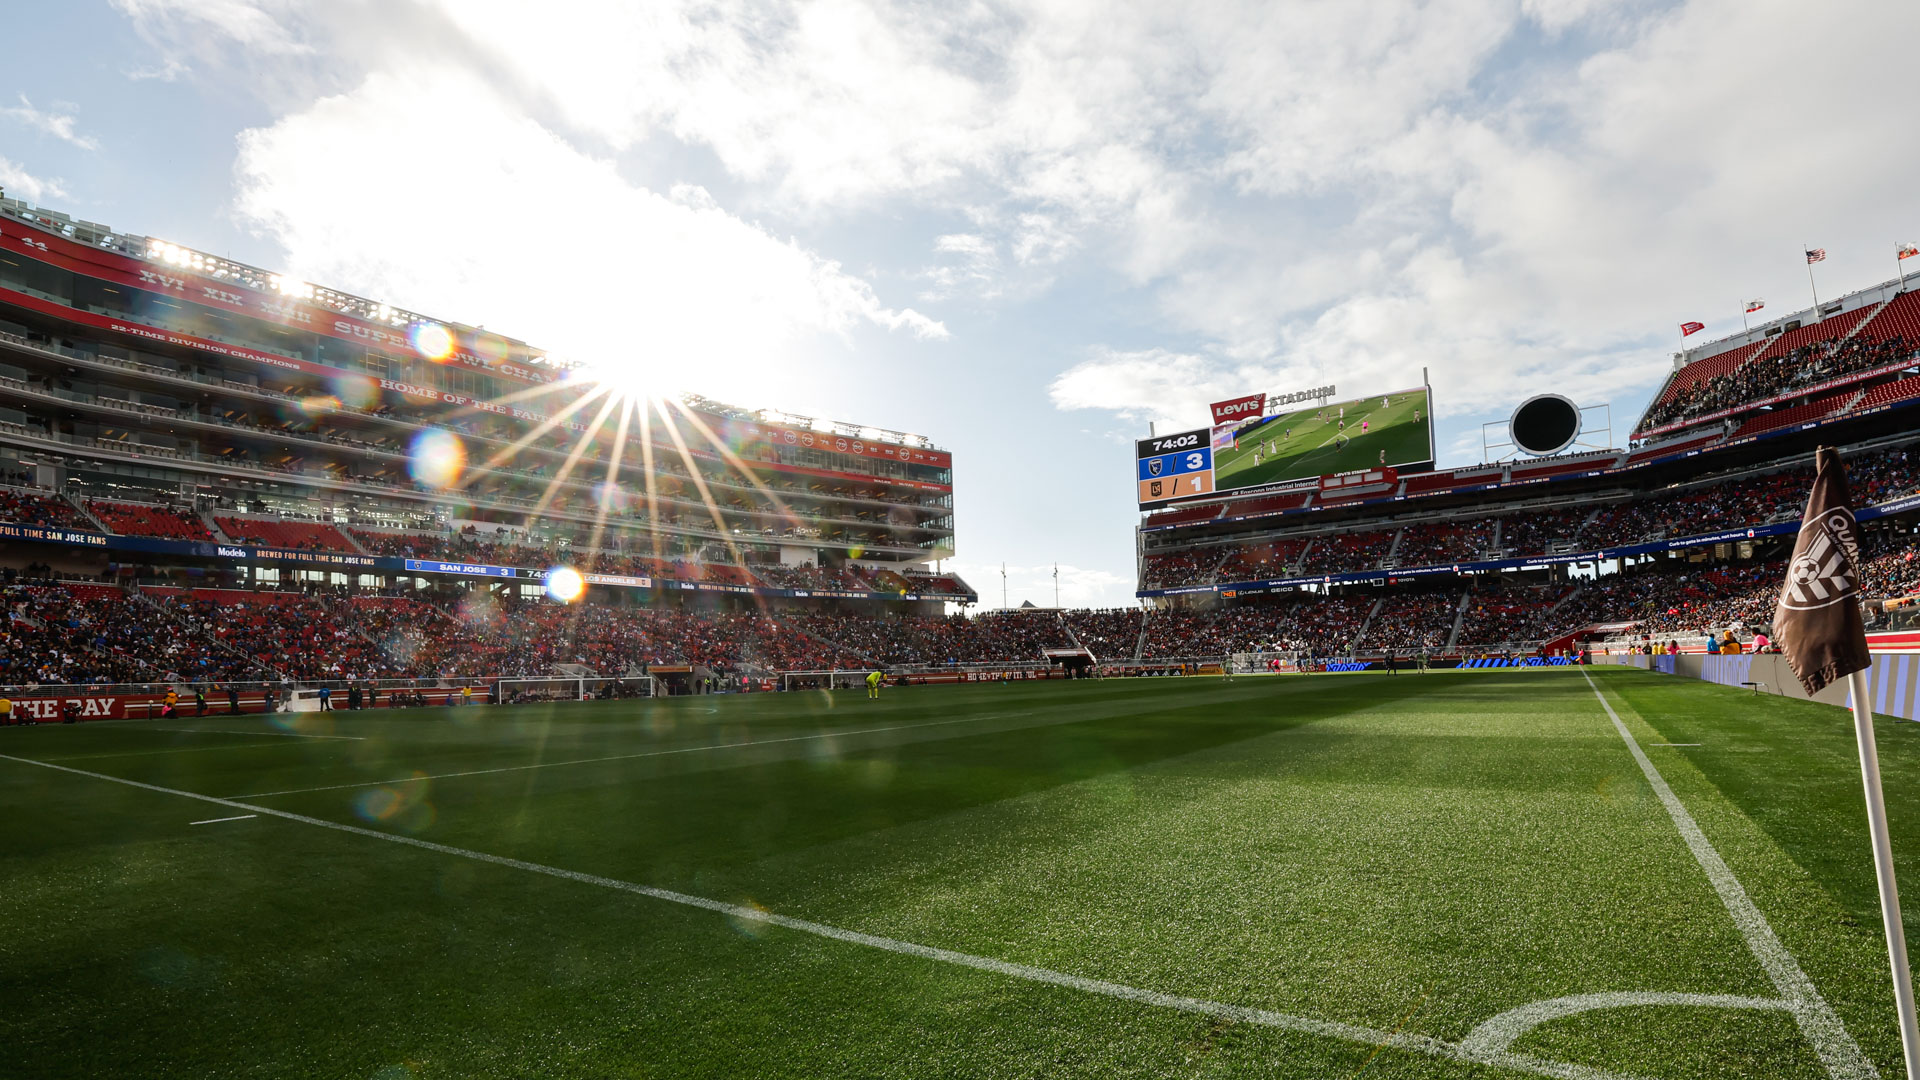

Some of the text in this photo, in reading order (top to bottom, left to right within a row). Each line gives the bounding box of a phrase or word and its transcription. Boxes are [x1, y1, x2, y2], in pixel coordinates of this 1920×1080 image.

[21, 237, 48, 252] 44
[139, 269, 185, 291] XVI
[203, 286, 243, 306] XIX
[111, 324, 300, 370] 22-TIME DIVISION CHAMPIONS
[1858, 368, 1887, 379] INCLUDE
[379, 379, 437, 400] HOME
[443, 394, 467, 405] OF
[471, 399, 506, 415] THE
[1269, 385, 1336, 407] STADIUM
[1152, 434, 1198, 451] 74:02
[1186, 453, 1203, 469] 3
[1191, 476, 1202, 492] 1
[1265, 483, 1294, 492] Industrial
[1294, 480, 1318, 488] Internet
[0, 526, 106, 545] FULL TIME SAN JOSE FANS
[218, 547, 246, 558] Modelo
[256, 550, 282, 559] BREWED
[284, 552, 297, 560] FOR
[298, 553, 313, 561] FULL
[361, 558, 375, 566] FANS
[440, 564, 509, 576] SAN JOSE 3
[527, 570, 552, 579] 74:0
[601, 576, 636, 584] ANGELES
